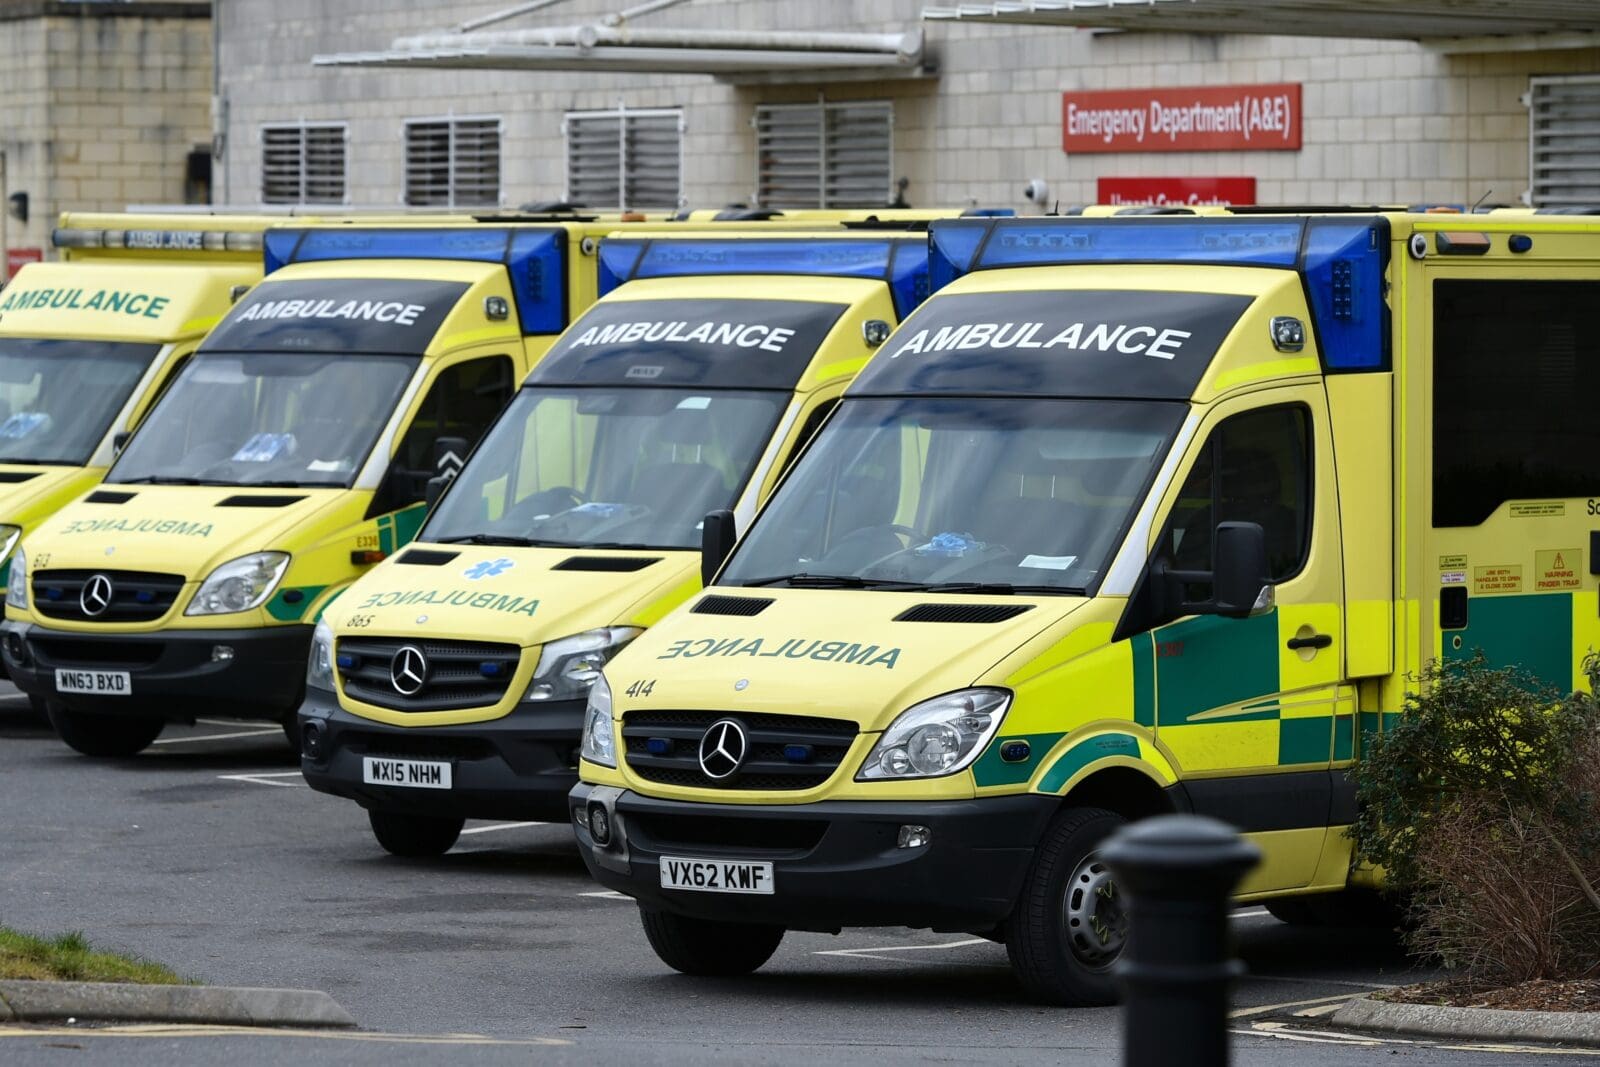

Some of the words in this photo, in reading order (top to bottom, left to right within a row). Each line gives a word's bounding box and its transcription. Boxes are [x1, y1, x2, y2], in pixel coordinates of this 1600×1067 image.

[1067, 103, 1147, 142] Emergency
[1151, 100, 1242, 142] Department
[1243, 95, 1291, 140] (A&E)
[1, 288, 170, 319] AMBULANCE
[235, 299, 426, 326] AMBULANCE
[569, 321, 796, 352] AMBULANCE
[891, 322, 1192, 360] AMBULANCE
[1544, 570, 1574, 578] WARNING
[346, 614, 375, 628] 865
[61, 671, 93, 689] WN63
[97, 674, 124, 690] BXD
[625, 679, 657, 698] 414
[372, 761, 404, 782] WX15
[409, 763, 441, 785] NHM
[668, 861, 719, 888] VX62
[724, 864, 765, 889] KWF
